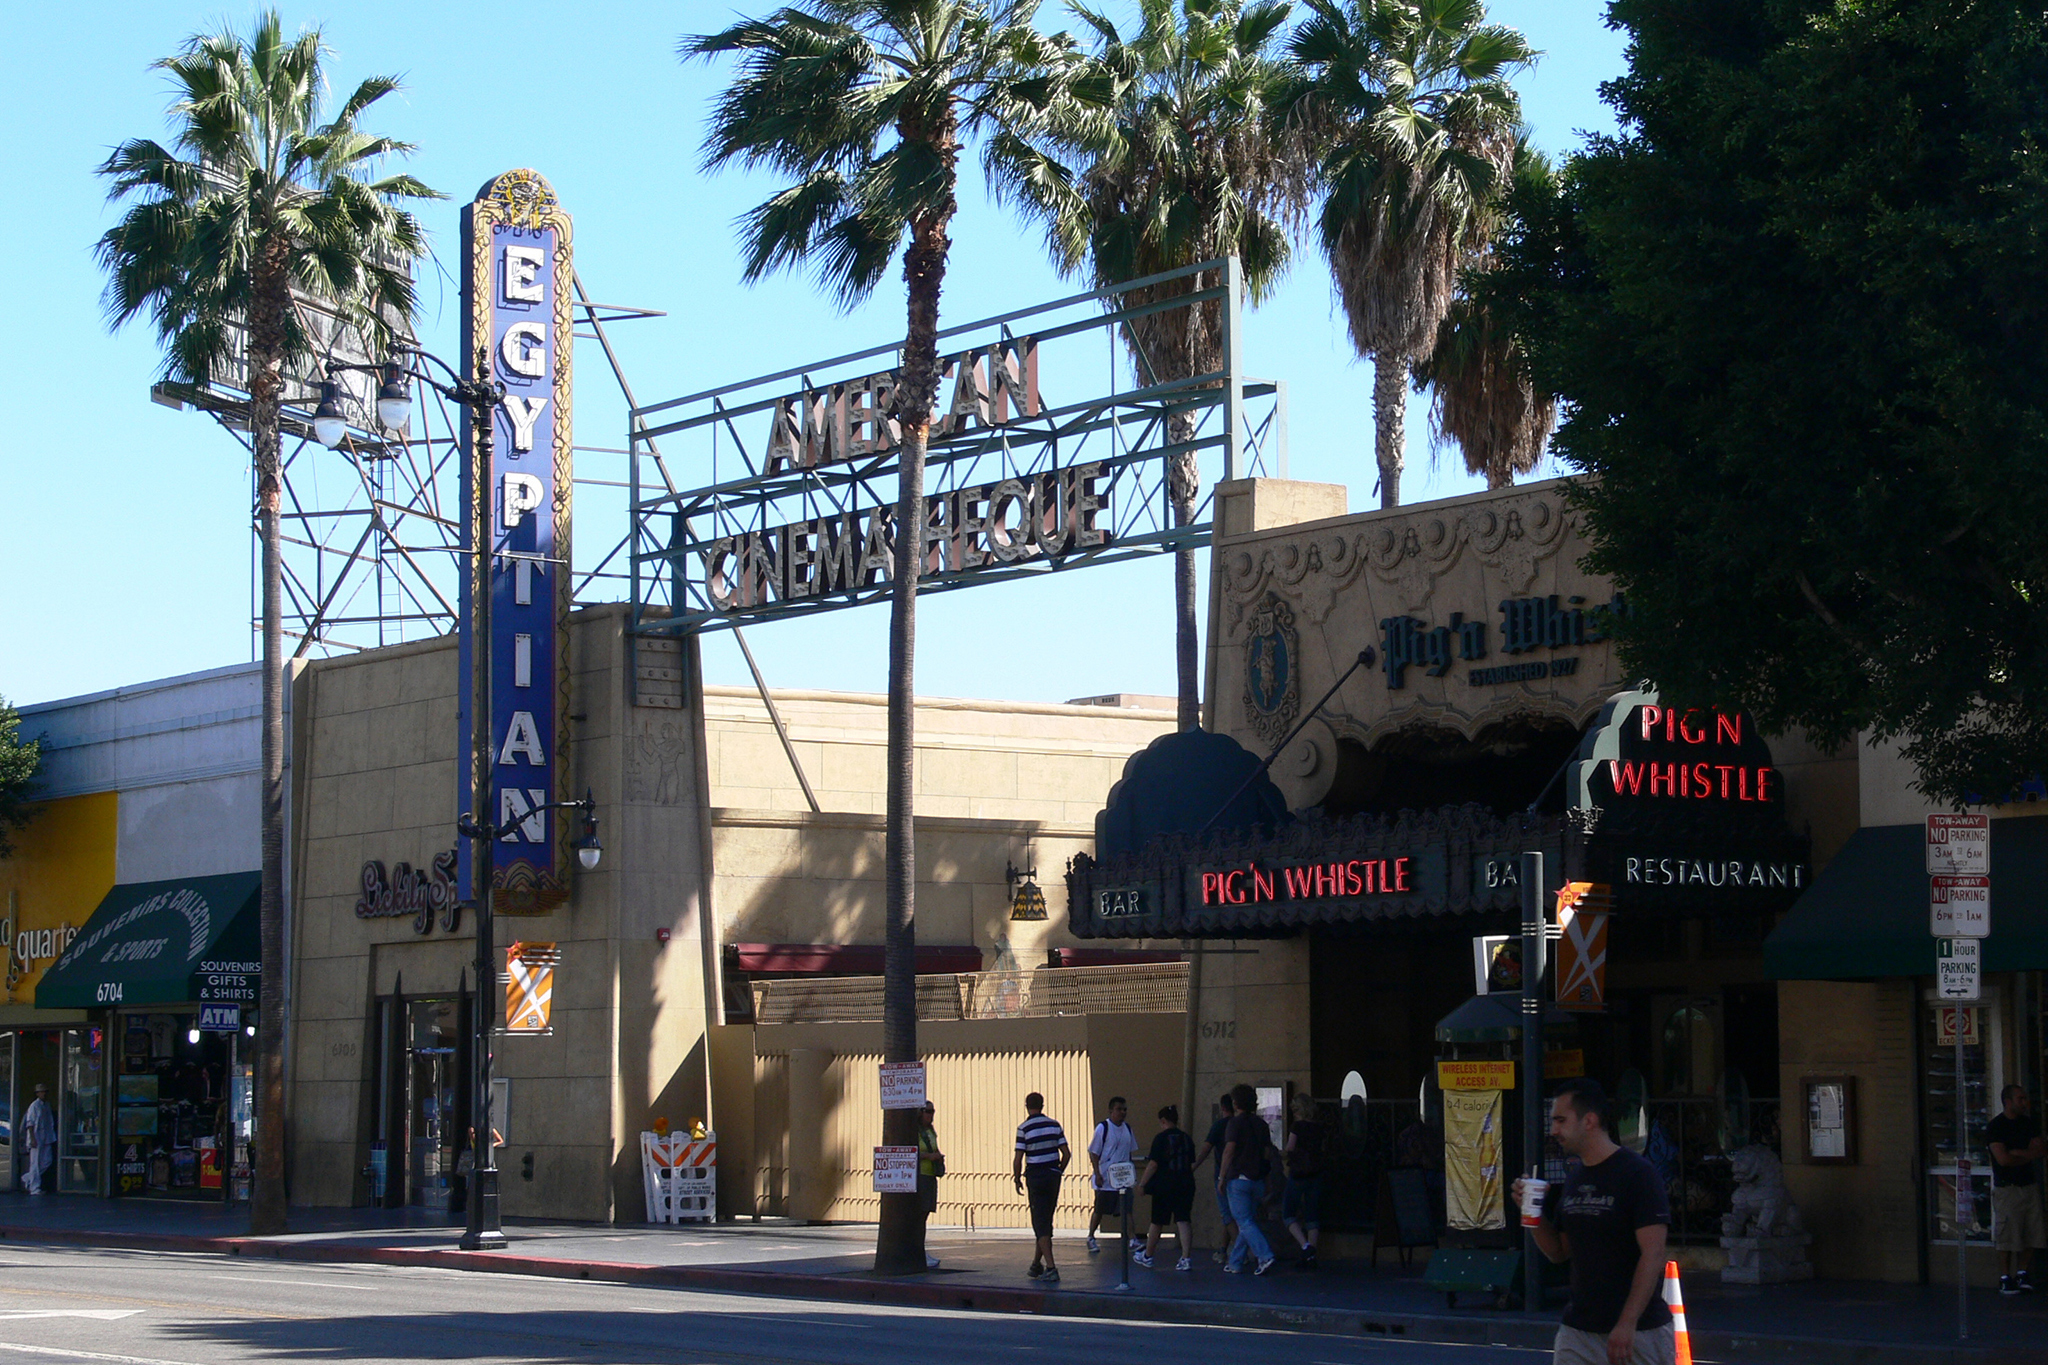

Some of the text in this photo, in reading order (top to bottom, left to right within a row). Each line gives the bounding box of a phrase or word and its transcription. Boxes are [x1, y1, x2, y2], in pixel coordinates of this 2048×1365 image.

[764, 336, 1038, 476] AMERCAN
[498, 245, 548, 843] EGYPTIAN
[706, 461, 1110, 612] CINEMAHEQUE
[1469, 662, 1548, 687] ESTABLISHED
[1610, 759, 1773, 802] WHISTLE
[1935, 817, 1980, 825] TOW-AWAY
[1931, 828, 1986, 842] NO PARKING
[1284, 856, 1410, 899] WHISTLE
[1485, 861, 1518, 889] BA
[1626, 857, 1804, 888] RESTAURANT
[1938, 878, 1981, 886] TOW-AWAY
[430, 850, 461, 932] Sp
[1932, 887, 1986, 902] NO PARKING
[1100, 889, 1140, 916] BAR
[59, 888, 211, 971] SOUVENIRS COLLECTION
[114, 937, 169, 962] SPORTS
[1942, 941, 1976, 956] 1 HOUR
[200, 961, 261, 972] SOUVENIRS
[1940, 962, 1977, 974] PARKING
[208, 975, 247, 987] GIFTS
[97, 982, 123, 1002] 6704
[200, 988, 255, 1000] & SHIRTS
[201, 1008, 238, 1025] ATM
[1442, 1063, 1511, 1074] WIRELESS INTERNET
[881, 1076, 923, 1087] NO PARKING
[1456, 1077, 1486, 1086] ACCESS
[1463, 1099, 1498, 1112] calori
[124, 1144, 139, 1162] 4
[875, 1159, 916, 1170] NO STOPPING
